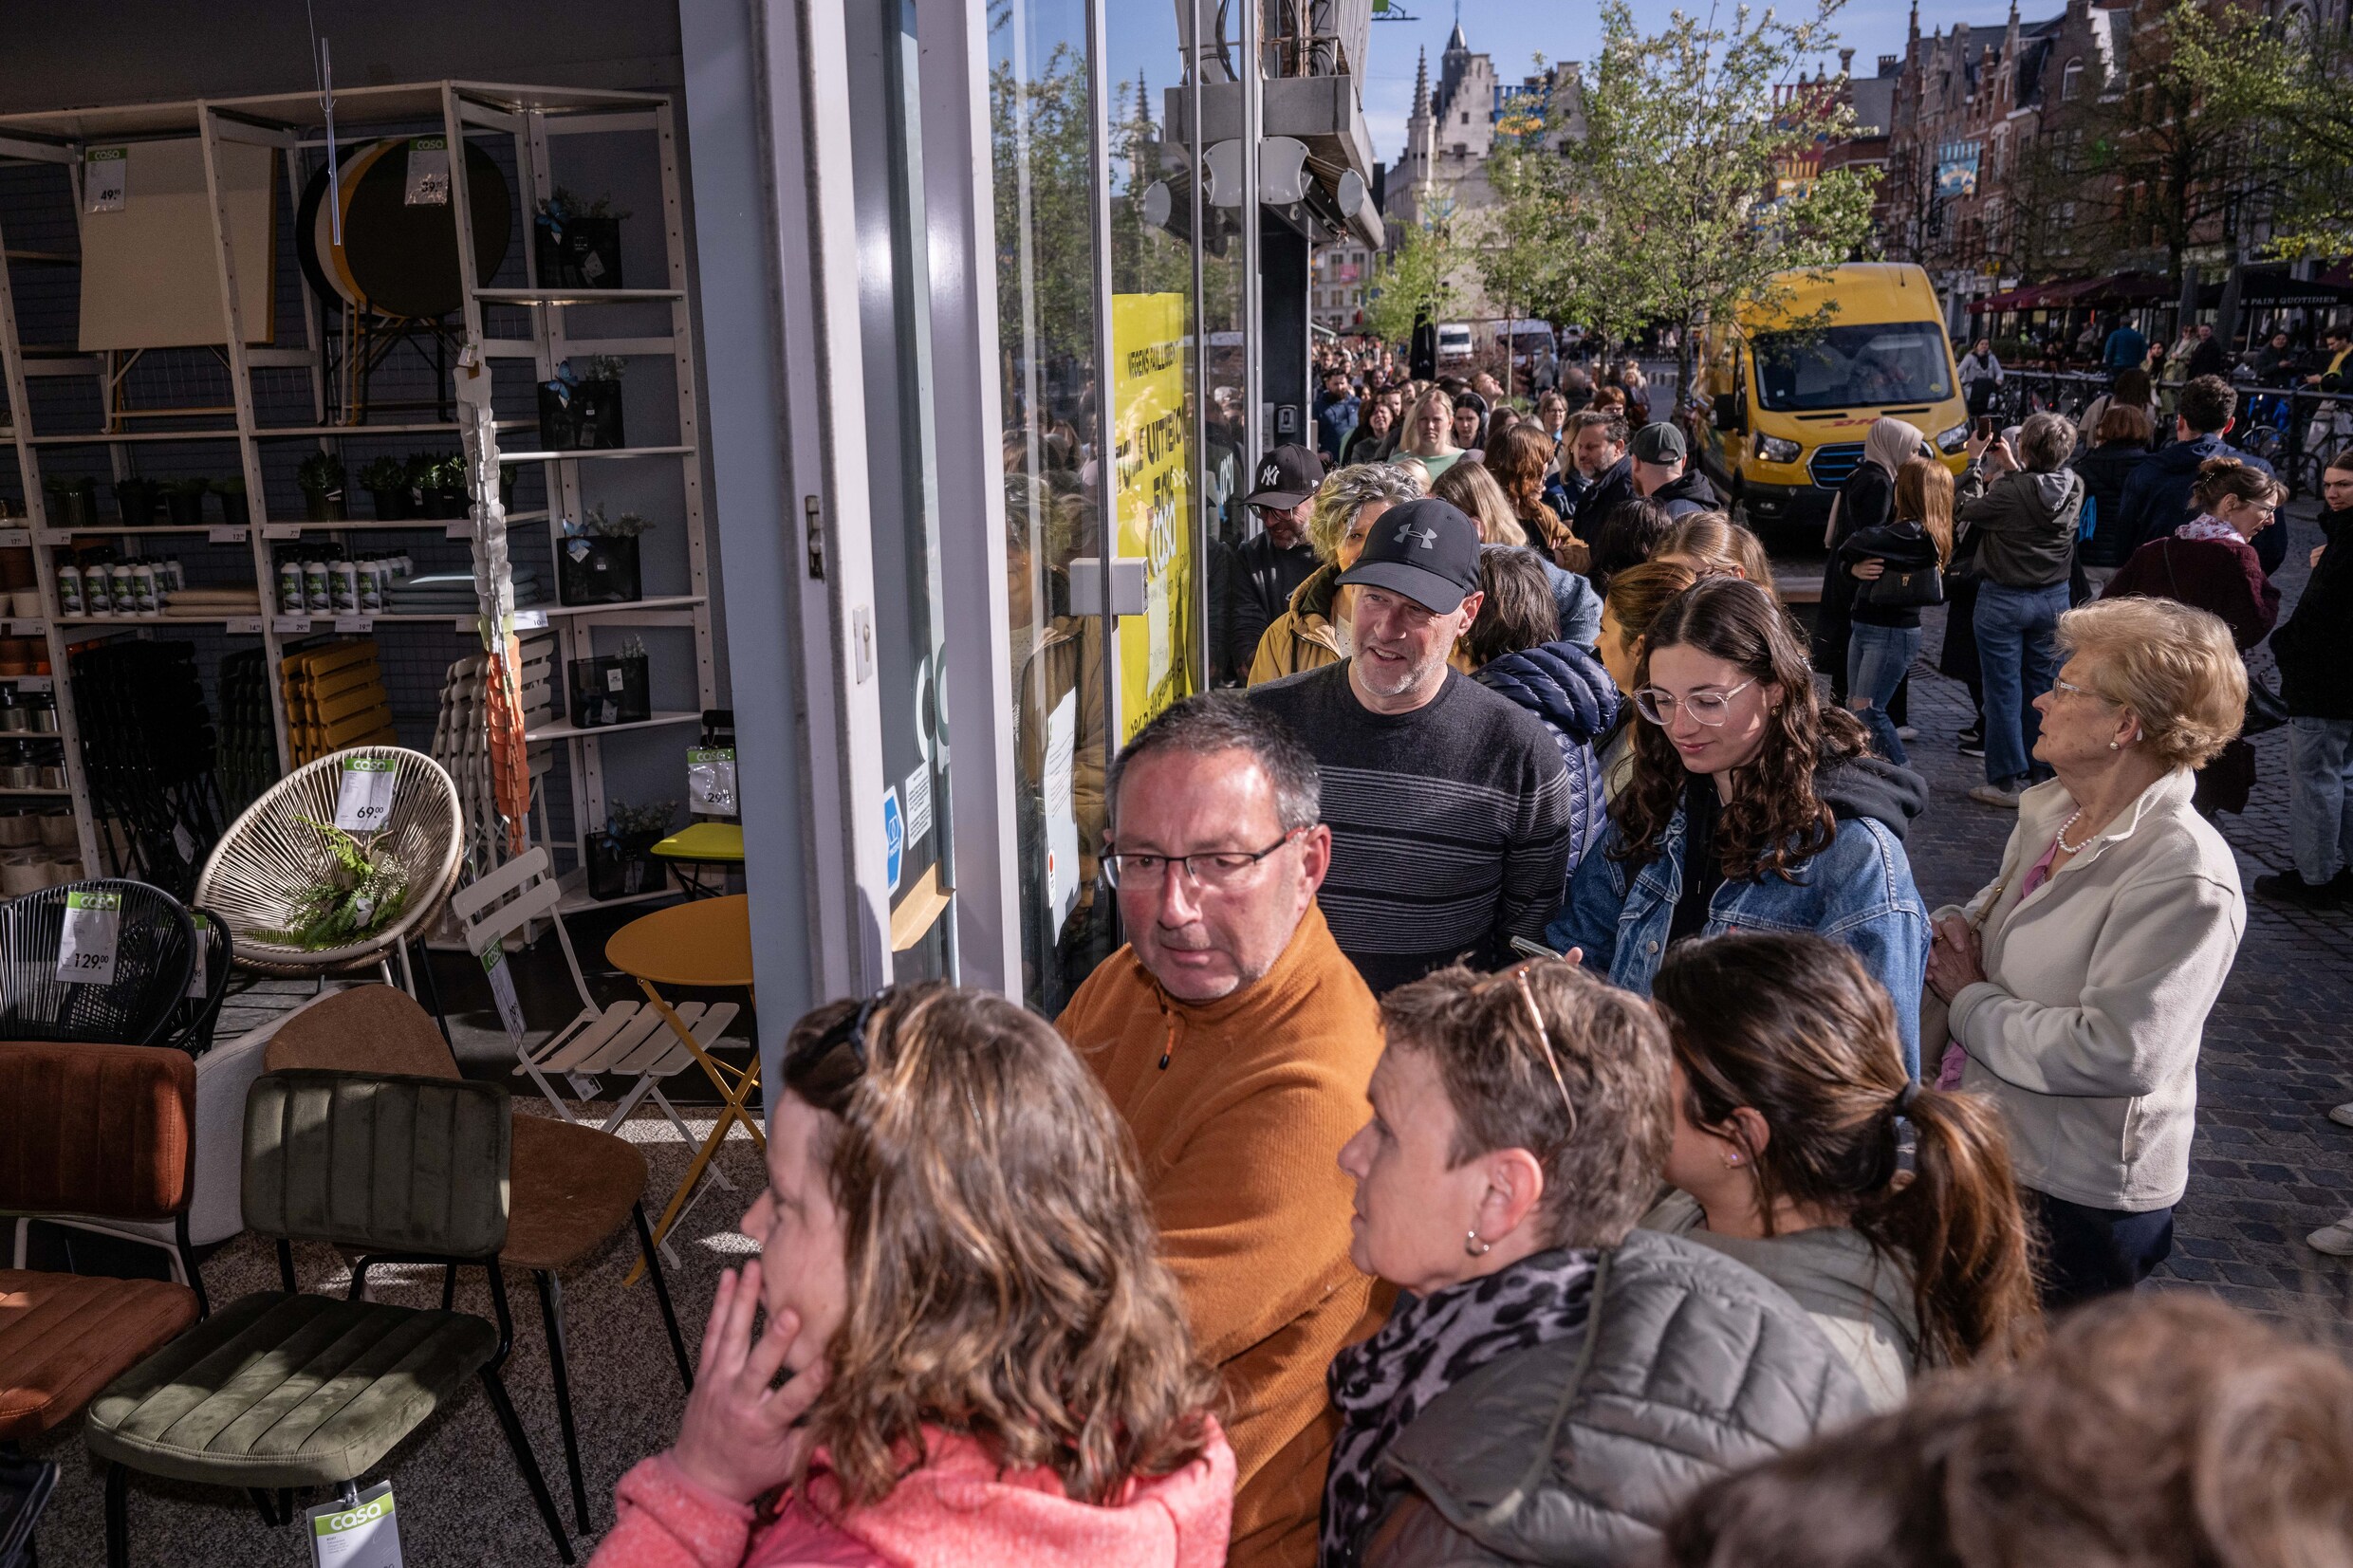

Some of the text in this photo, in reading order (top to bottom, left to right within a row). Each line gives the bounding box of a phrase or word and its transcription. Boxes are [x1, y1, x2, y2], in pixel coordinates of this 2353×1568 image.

[417, 139, 443, 150] casa
[95, 150, 120, 160] casa
[2251, 297, 2275, 305] PAIN
[2279, 296, 2339, 304] QUOTIDIEN
[1833, 418, 1880, 427] DH
[1261, 465, 1280, 486] NY
[697, 750, 726, 763] casa
[353, 760, 386, 770] casa
[357, 806, 384, 820] 69.00
[75, 952, 109, 969] 129.00
[330, 1503, 382, 1532] casa
